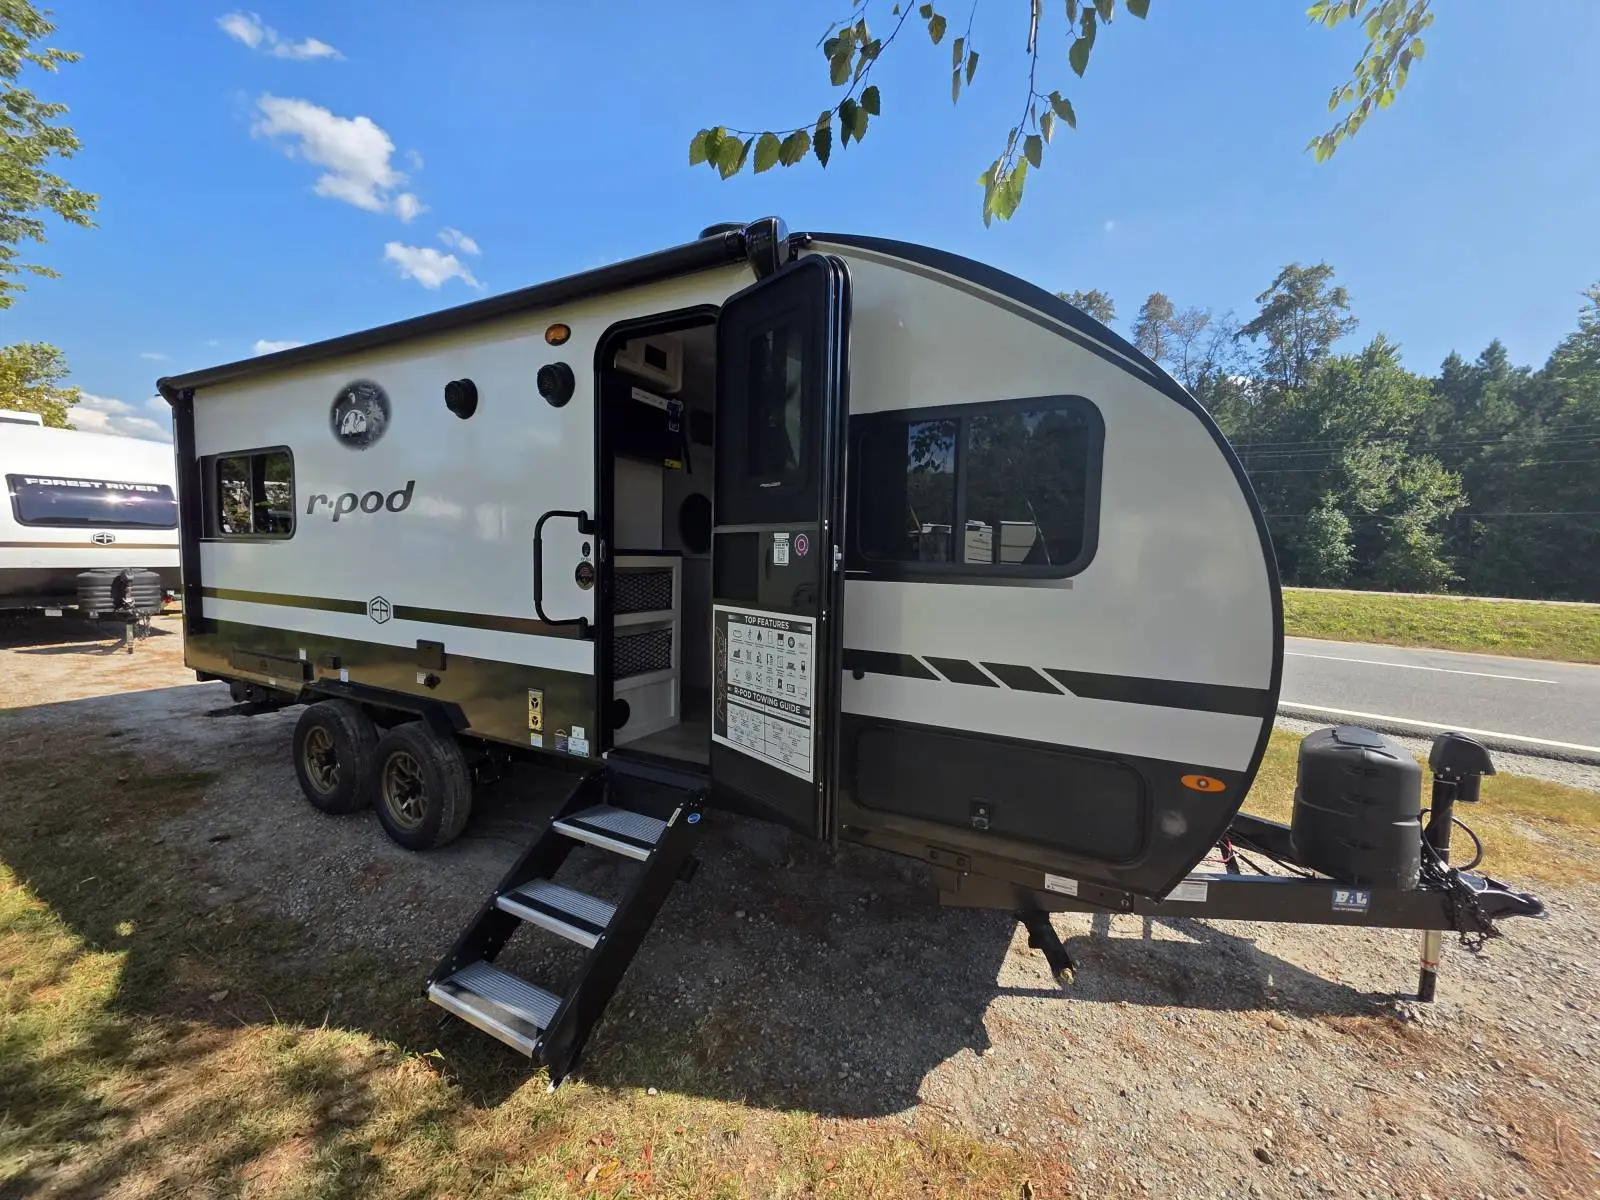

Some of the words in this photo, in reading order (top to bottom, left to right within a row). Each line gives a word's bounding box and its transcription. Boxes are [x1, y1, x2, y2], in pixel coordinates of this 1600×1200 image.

[24, 477, 103, 489] FOREST
[105, 482, 159, 493] RIVER
[744, 615, 757, 625] TOP
[757, 618, 790, 630] FEATURES
[734, 686, 752, 699] R-POD
[752, 692, 779, 707] TOWING
[779, 701, 801, 714] GUIDE
